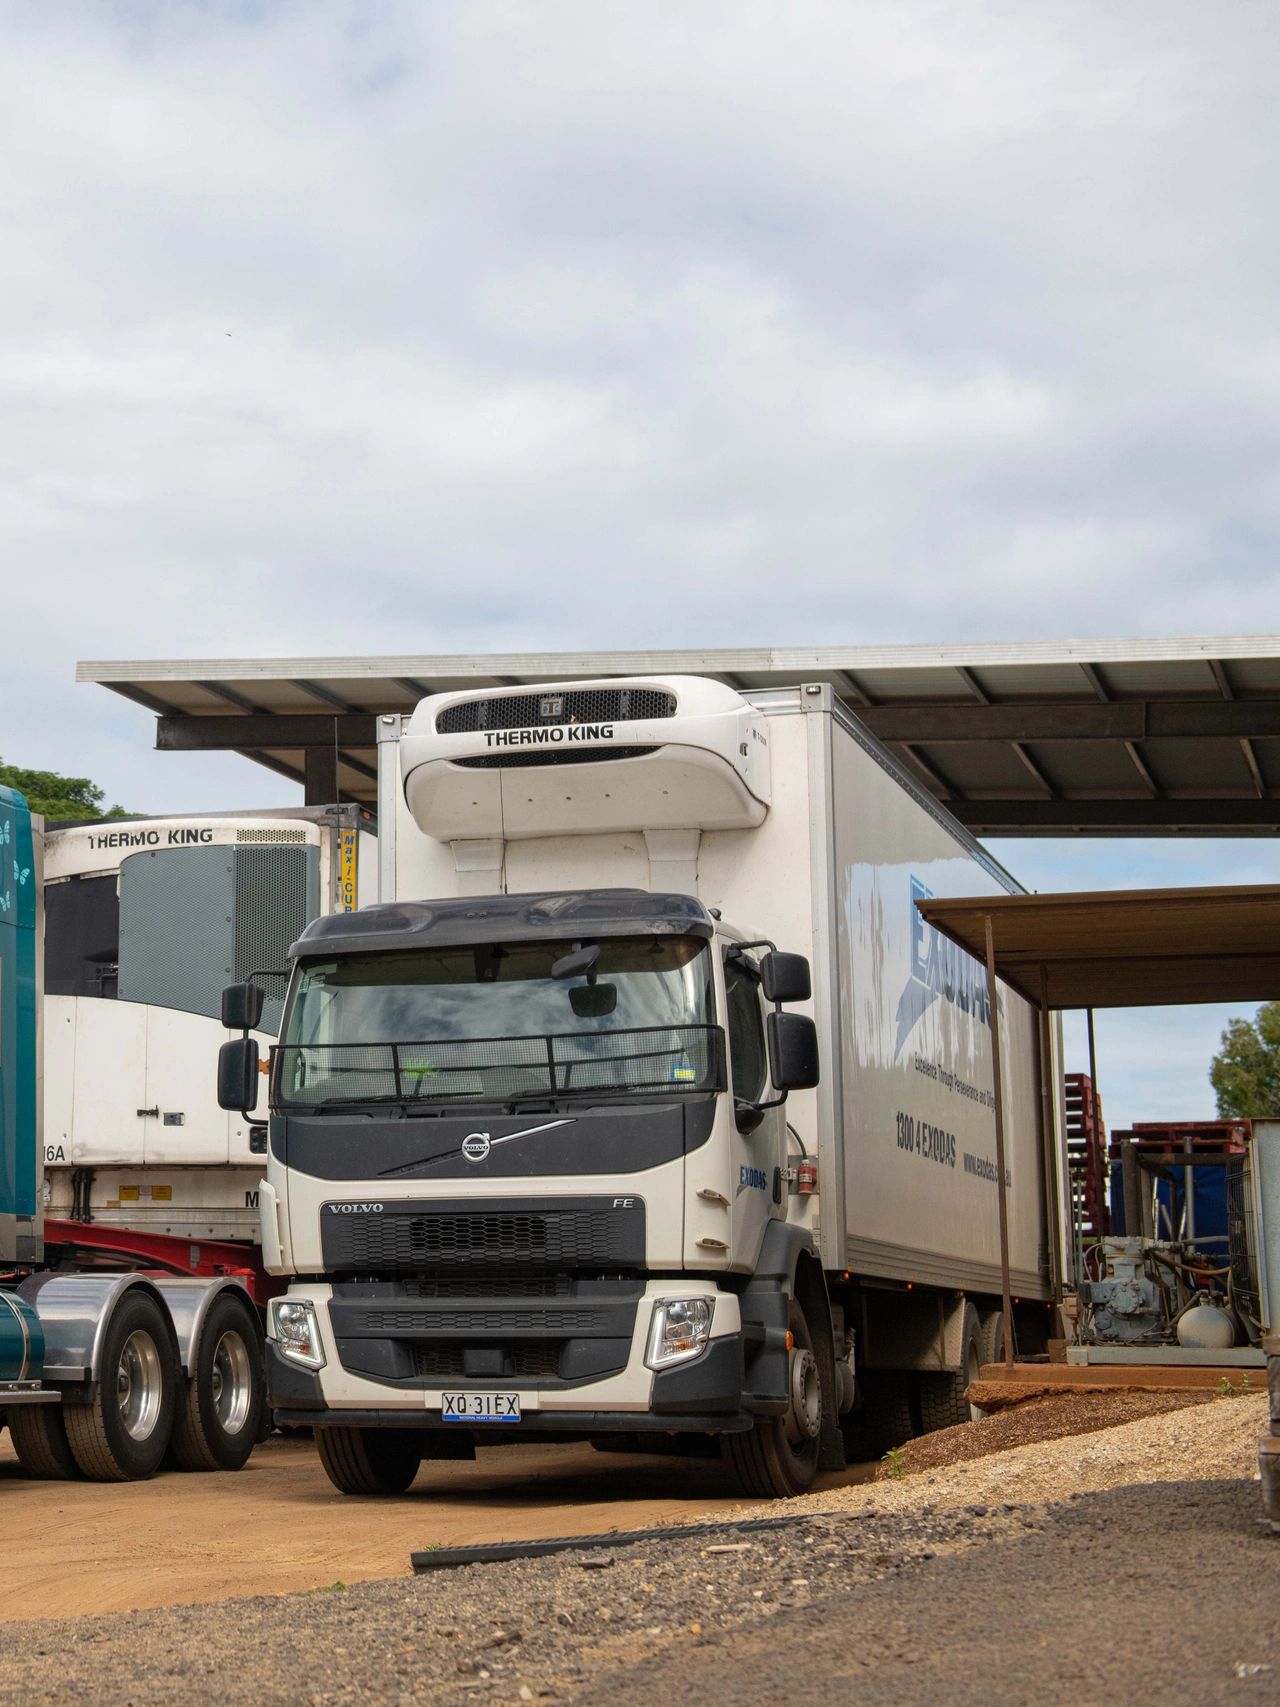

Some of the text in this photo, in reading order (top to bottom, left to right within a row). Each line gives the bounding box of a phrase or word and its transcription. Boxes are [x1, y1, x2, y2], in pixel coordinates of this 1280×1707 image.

[484, 724, 613, 747] THERMO KING
[87, 828, 213, 849] THERMO KING
[896, 1111, 914, 1152] 1300
[915, 1120, 921, 1155] 4
[922, 1122, 956, 1168] EXODAS
[740, 1166, 767, 1191] EXODAS
[329, 1203, 384, 1214] VOLVO
[612, 1198, 635, 1208] FE
